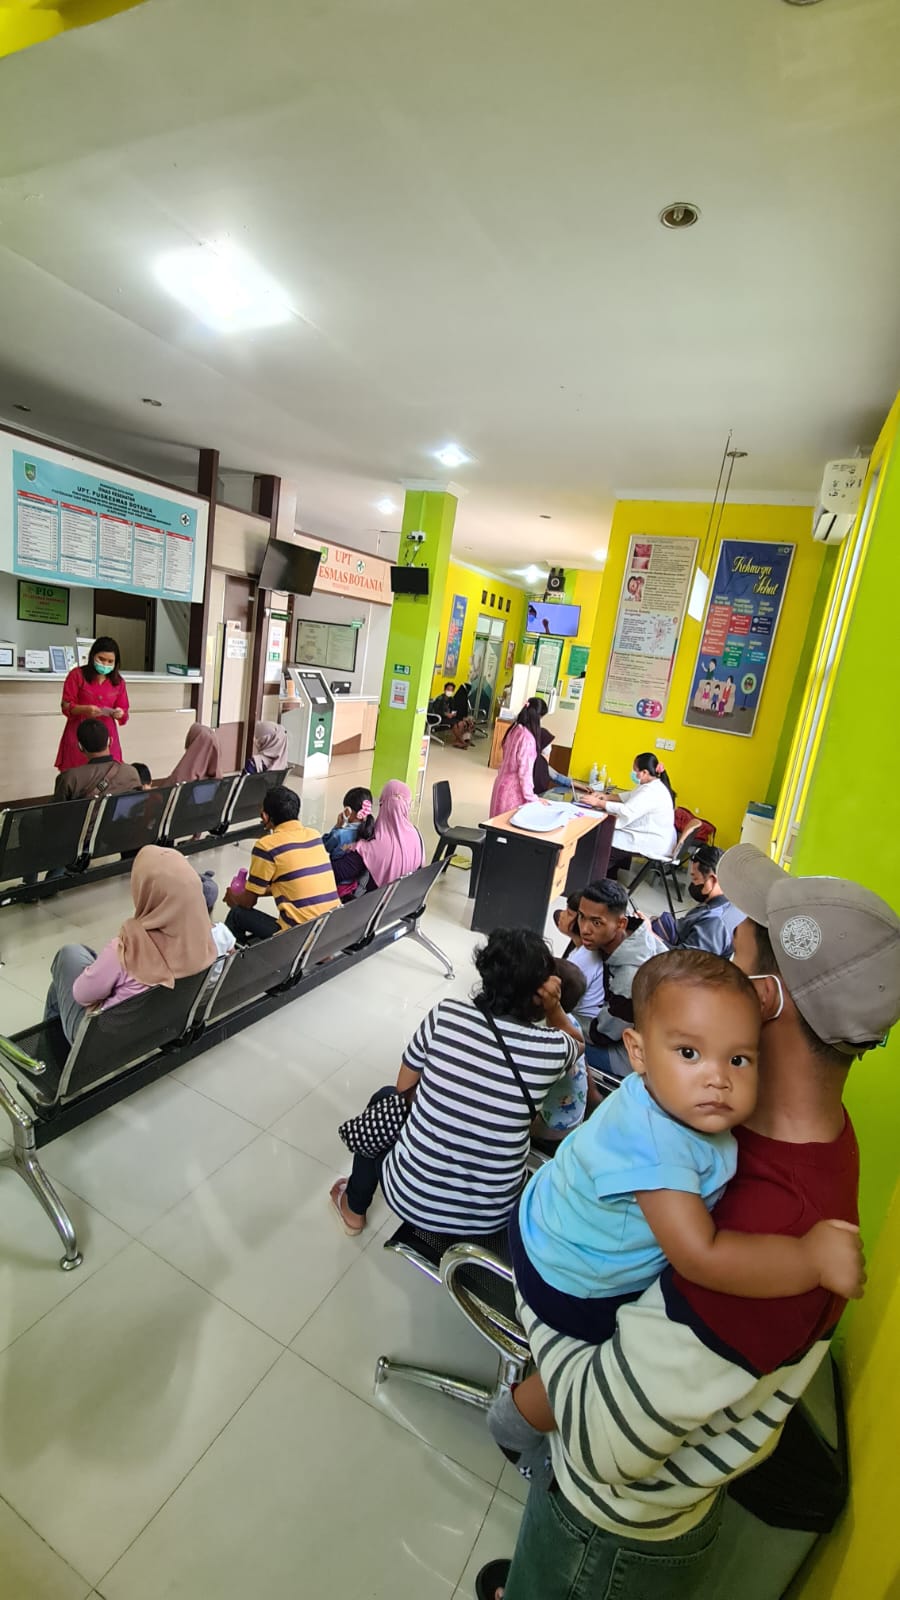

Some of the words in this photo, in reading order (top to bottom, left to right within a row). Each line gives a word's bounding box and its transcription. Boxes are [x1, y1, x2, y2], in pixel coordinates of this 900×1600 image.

[92, 490, 128, 506] PUSKESMAS
[129, 501, 153, 513] BOTANIA
[335, 550, 352, 565] UPT
[731, 556, 772, 580] Keluarga
[319, 566, 348, 583] ESMAS
[348, 573, 383, 592] BOTANIA
[753, 575, 779, 595] Sehat
[36, 586, 54, 597] PIO
